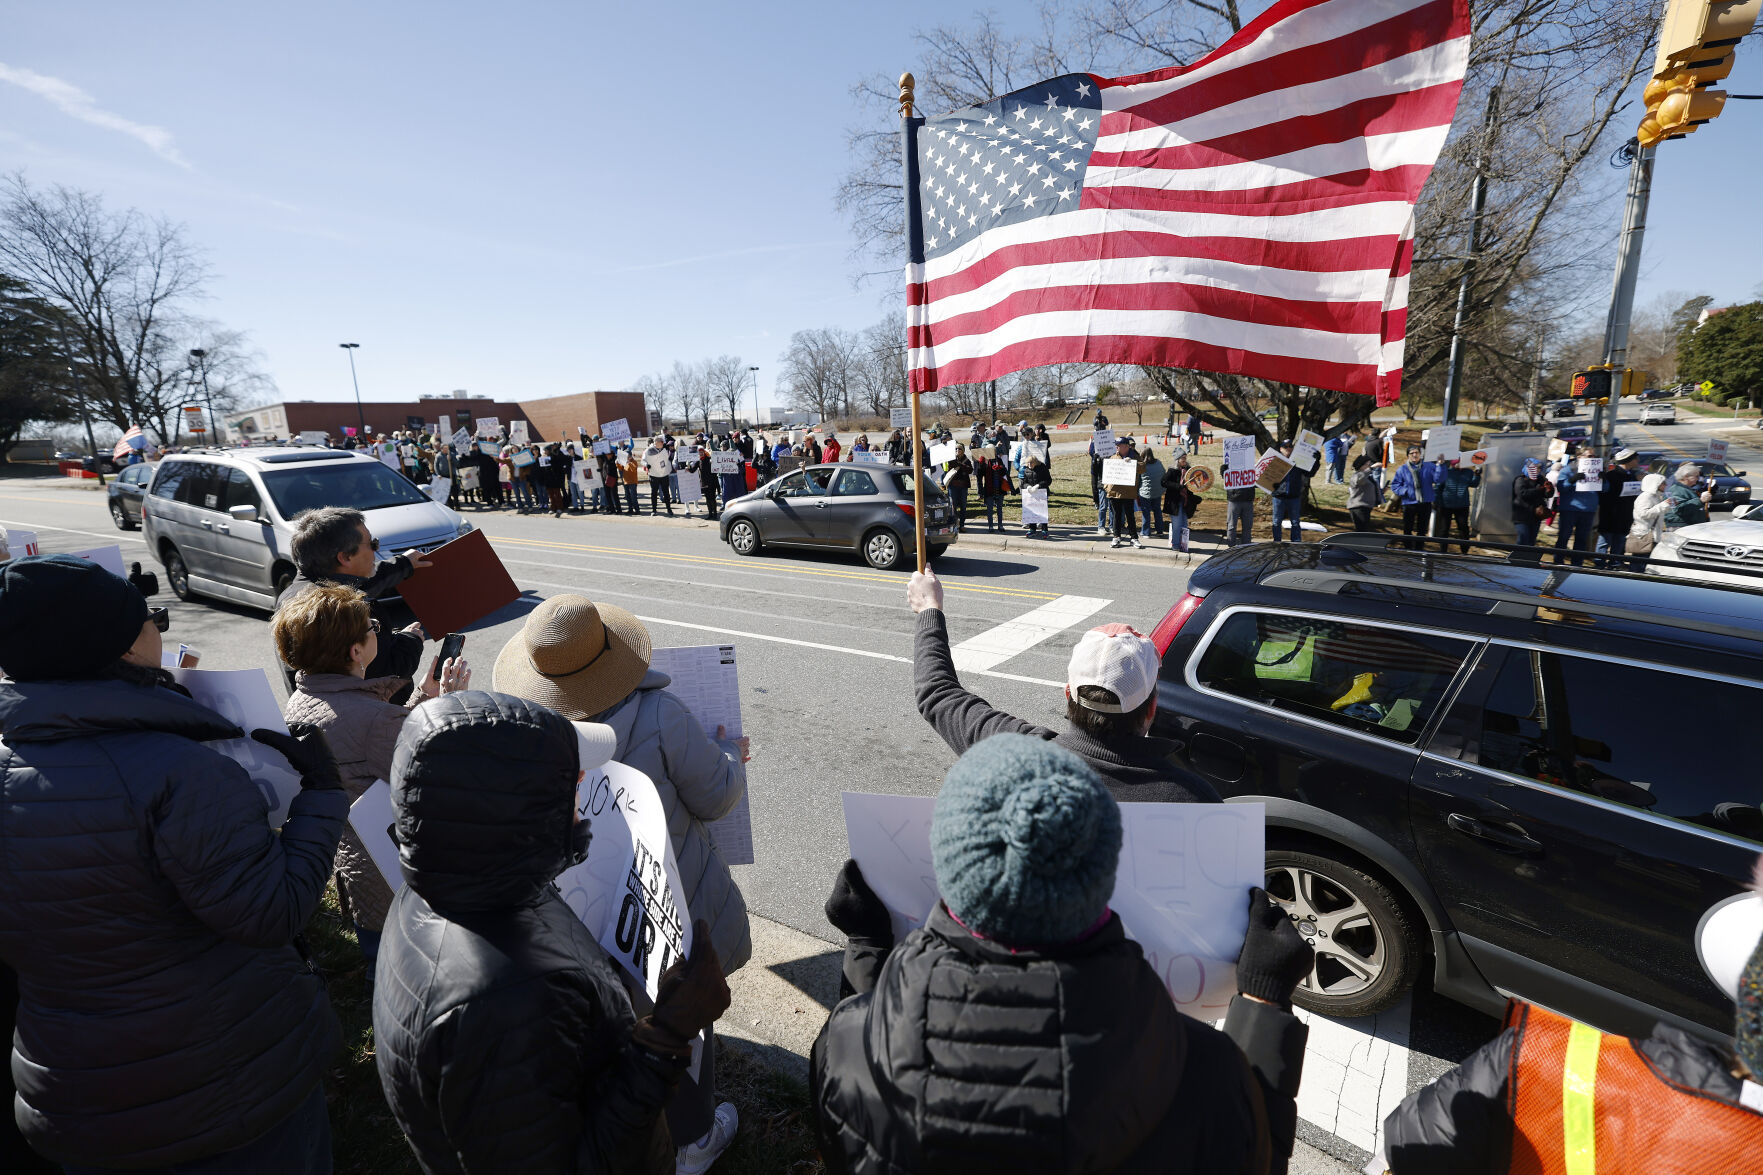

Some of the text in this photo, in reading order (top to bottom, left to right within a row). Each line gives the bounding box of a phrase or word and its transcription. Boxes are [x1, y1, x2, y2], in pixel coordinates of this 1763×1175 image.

[1225, 470, 1256, 487] OUTRAGED
[632, 838, 661, 896] IT'S
[615, 893, 656, 981] OR
[628, 872, 650, 909] WHOSE
[649, 899, 665, 928] SIDE
[663, 918, 677, 945] ARE
